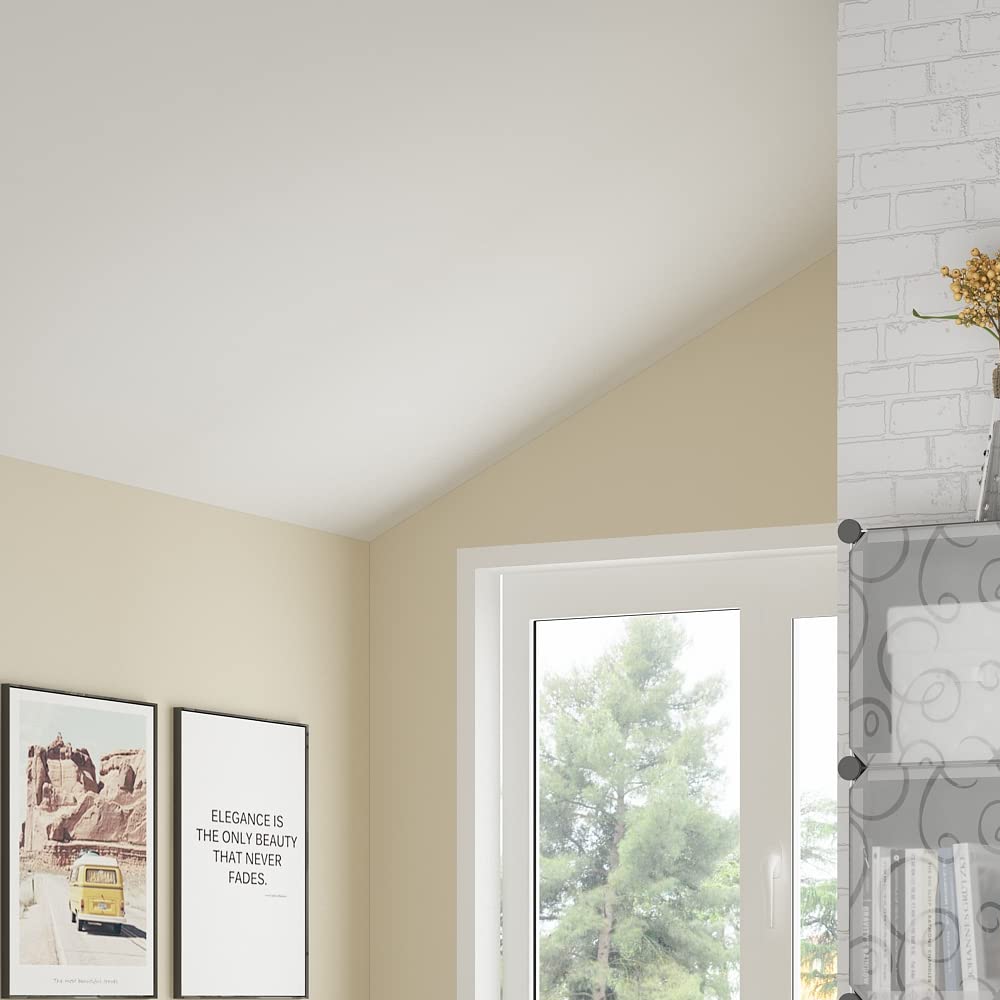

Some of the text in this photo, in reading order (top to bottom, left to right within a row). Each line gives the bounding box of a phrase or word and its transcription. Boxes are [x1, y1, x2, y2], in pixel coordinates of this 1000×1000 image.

[211, 809, 284, 828] ELEGANCE IS
[196, 828, 298, 848] THE ONLY BEAUTY
[212, 849, 282, 867] THAT NEVER
[228, 870, 268, 886] FADES.
